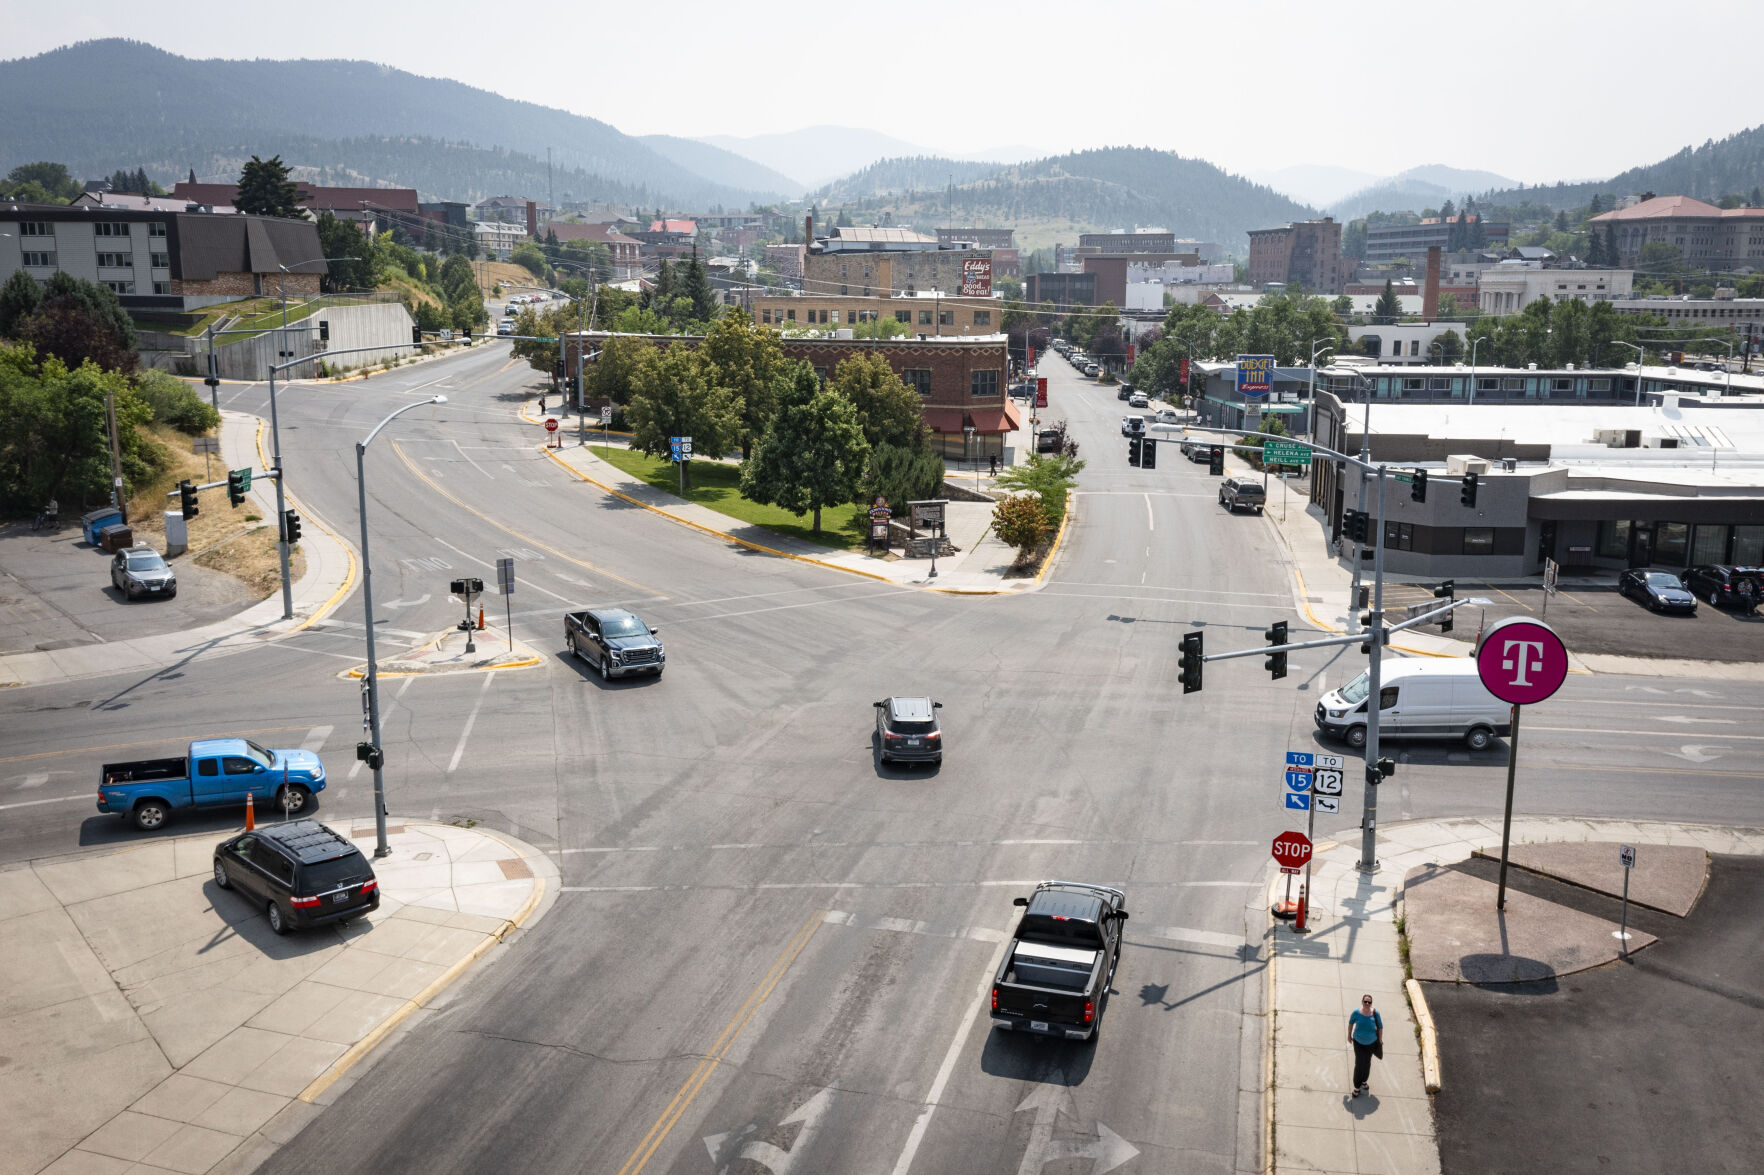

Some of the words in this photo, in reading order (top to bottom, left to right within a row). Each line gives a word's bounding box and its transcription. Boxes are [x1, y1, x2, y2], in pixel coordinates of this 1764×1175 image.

[964, 261, 990, 273] Eddy's
[1241, 358, 1272, 370] BUDGET
[1246, 371, 1265, 383] INN
[1502, 640, 1544, 687] T
[1293, 755, 1307, 763] TO
[1323, 757, 1337, 766] TO
[1291, 774, 1307, 787] 15
[1320, 774, 1337, 789] 12
[1274, 841, 1311, 858] STOP
[1621, 853, 1633, 862] NO
